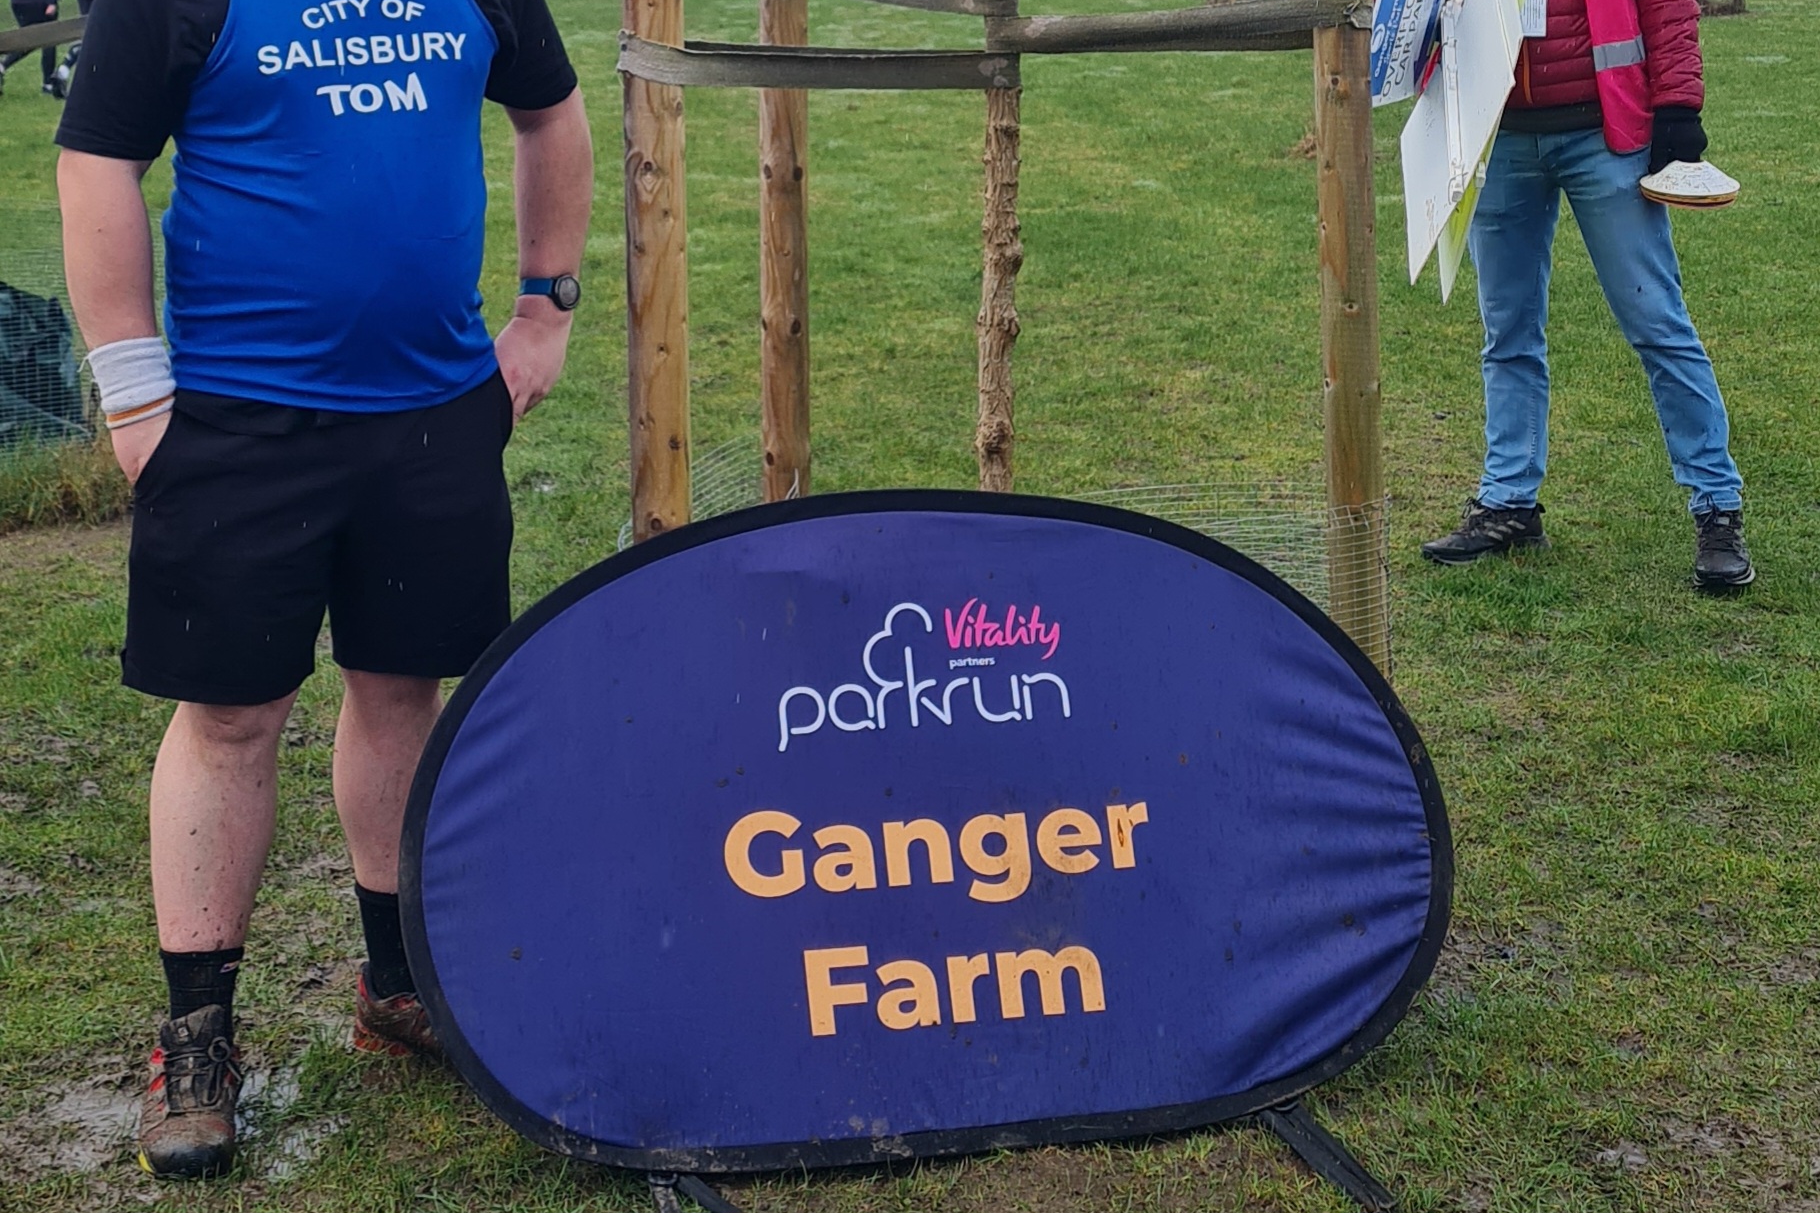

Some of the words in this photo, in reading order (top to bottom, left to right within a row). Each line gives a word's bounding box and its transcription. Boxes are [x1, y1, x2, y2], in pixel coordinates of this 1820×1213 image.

[257, 32, 466, 75] SALISBURY
[1394, 40, 1413, 86] CAR
[316, 72, 428, 116] TOM
[944, 597, 1060, 660] Vitality
[778, 602, 1072, 752] parkrun
[949, 657, 996, 670] partners
[724, 801, 1149, 903] Ganger
[803, 945, 1107, 1037] Farm
